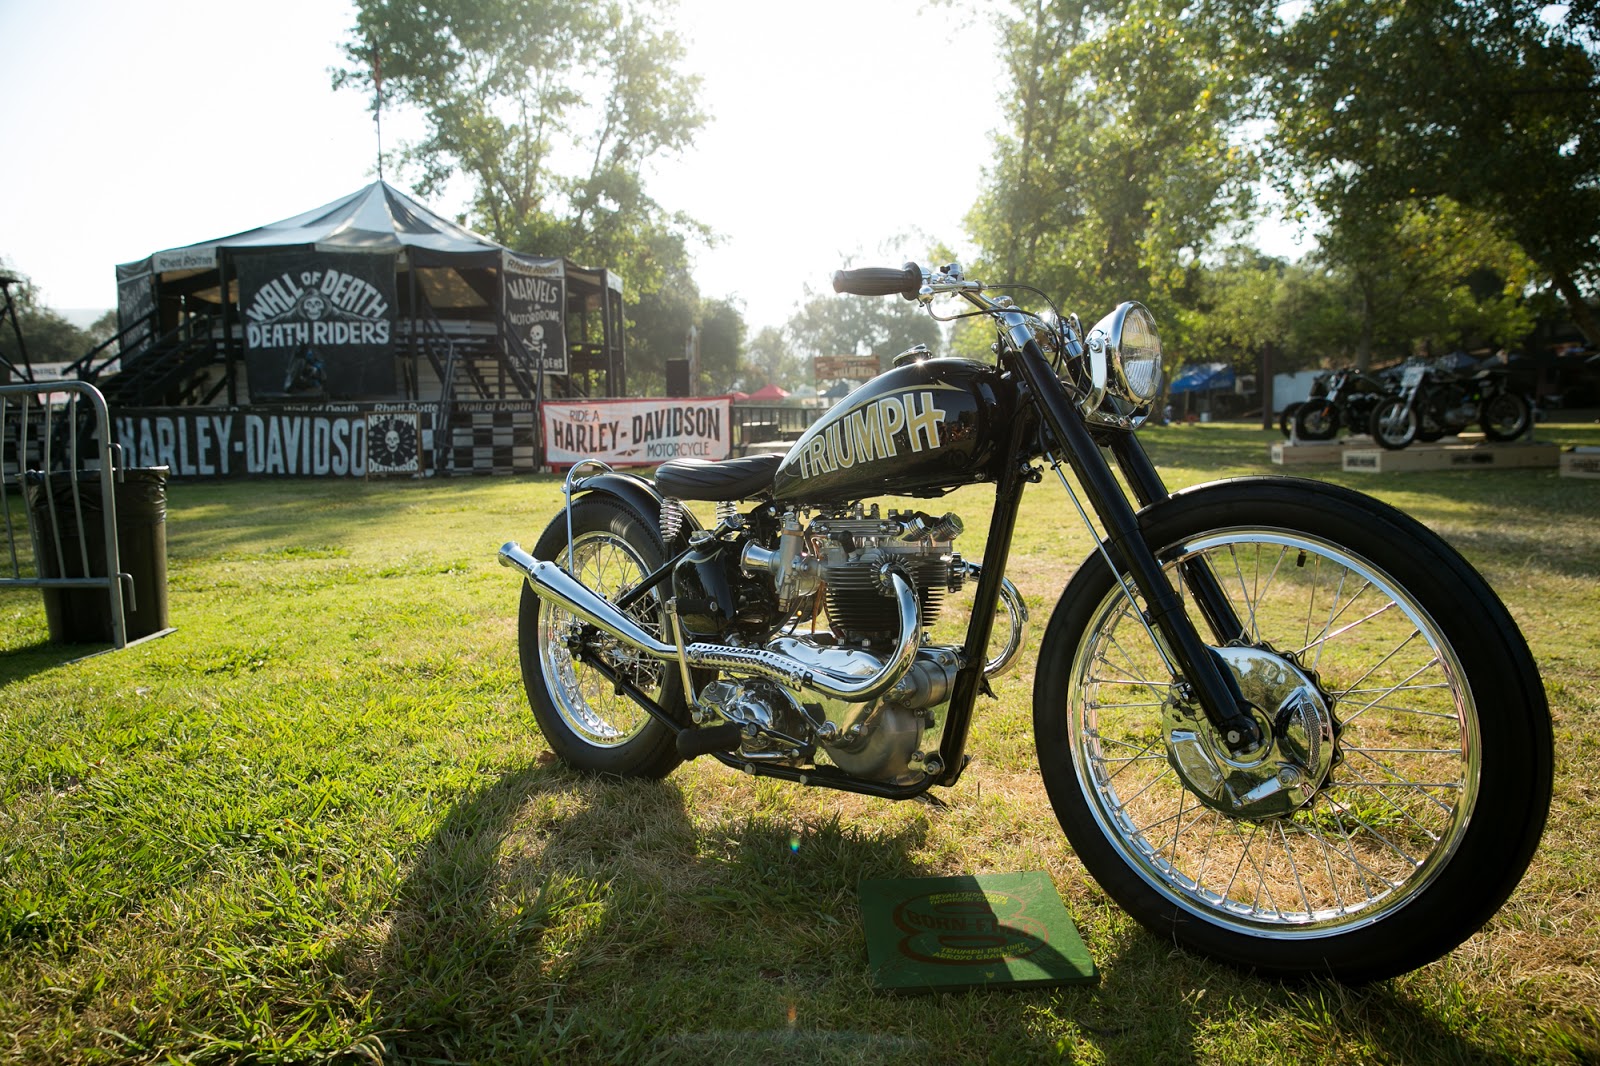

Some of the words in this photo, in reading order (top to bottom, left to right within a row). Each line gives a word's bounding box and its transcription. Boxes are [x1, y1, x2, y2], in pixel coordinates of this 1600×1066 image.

[246, 273, 304, 322] WALL
[300, 271, 322, 286] OF
[320, 269, 388, 319] DEATH
[507, 278, 558, 304] MARVELS
[508, 310, 561, 326] MOTORDROME
[249, 322, 309, 348] DEATH
[313, 320, 390, 345] RIDERS
[535, 357, 563, 369] RDERS
[374, 402, 406, 412] Rhett
[408, 402, 439, 413] Rotte
[457, 402, 482, 411] Wall
[484, 402, 497, 411] of
[498, 402, 532, 411] Death
[368, 413, 392, 430] NEXT
[392, 413, 417, 430] SHOW
[569, 410, 590, 424] RIDE
[591, 409, 600, 422] A
[790, 392, 946, 480] TRIUMPH
[117, 415, 366, 476] HARLEY-DAVIDSO
[646, 441, 711, 458] MOTORCYCLE
[368, 457, 394, 473] DEATH
[394, 455, 419, 472] RIDERS
[930, 897, 974, 905] THOMPSON
[960, 893, 1009, 902] THOMPSON
[932, 952, 973, 961] ARROYO
[1018, 946, 1031, 954] CA
[942, 947, 984, 955] TRIUMPH
